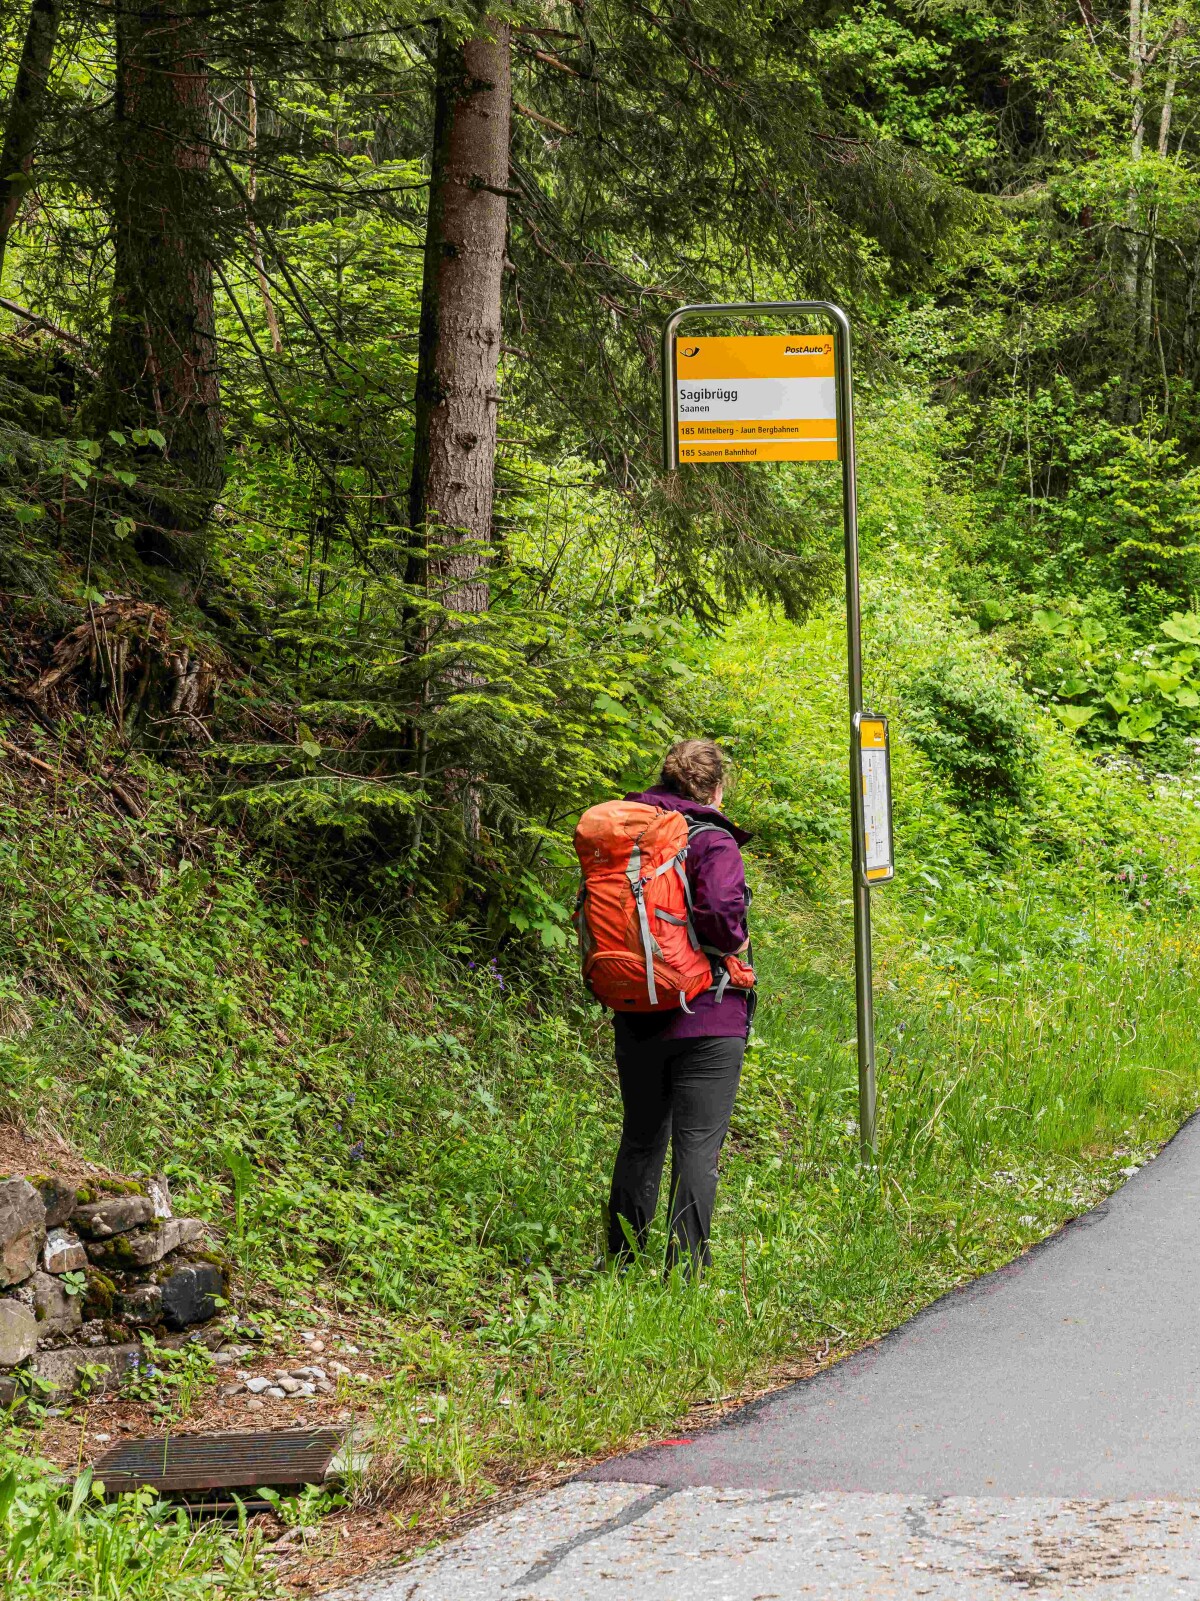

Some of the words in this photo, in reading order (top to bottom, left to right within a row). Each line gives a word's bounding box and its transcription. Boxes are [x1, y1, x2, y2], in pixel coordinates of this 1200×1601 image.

[785, 345, 824, 354] PostAuto
[680, 388, 738, 402] Sagibrügg
[680, 404, 710, 413] Saanen
[681, 427, 695, 435] 185
[697, 427, 734, 436] Mittelberg
[757, 426, 799, 435] Bergbahnen
[681, 449, 696, 457] 185
[697, 449, 723, 457] Saanen
